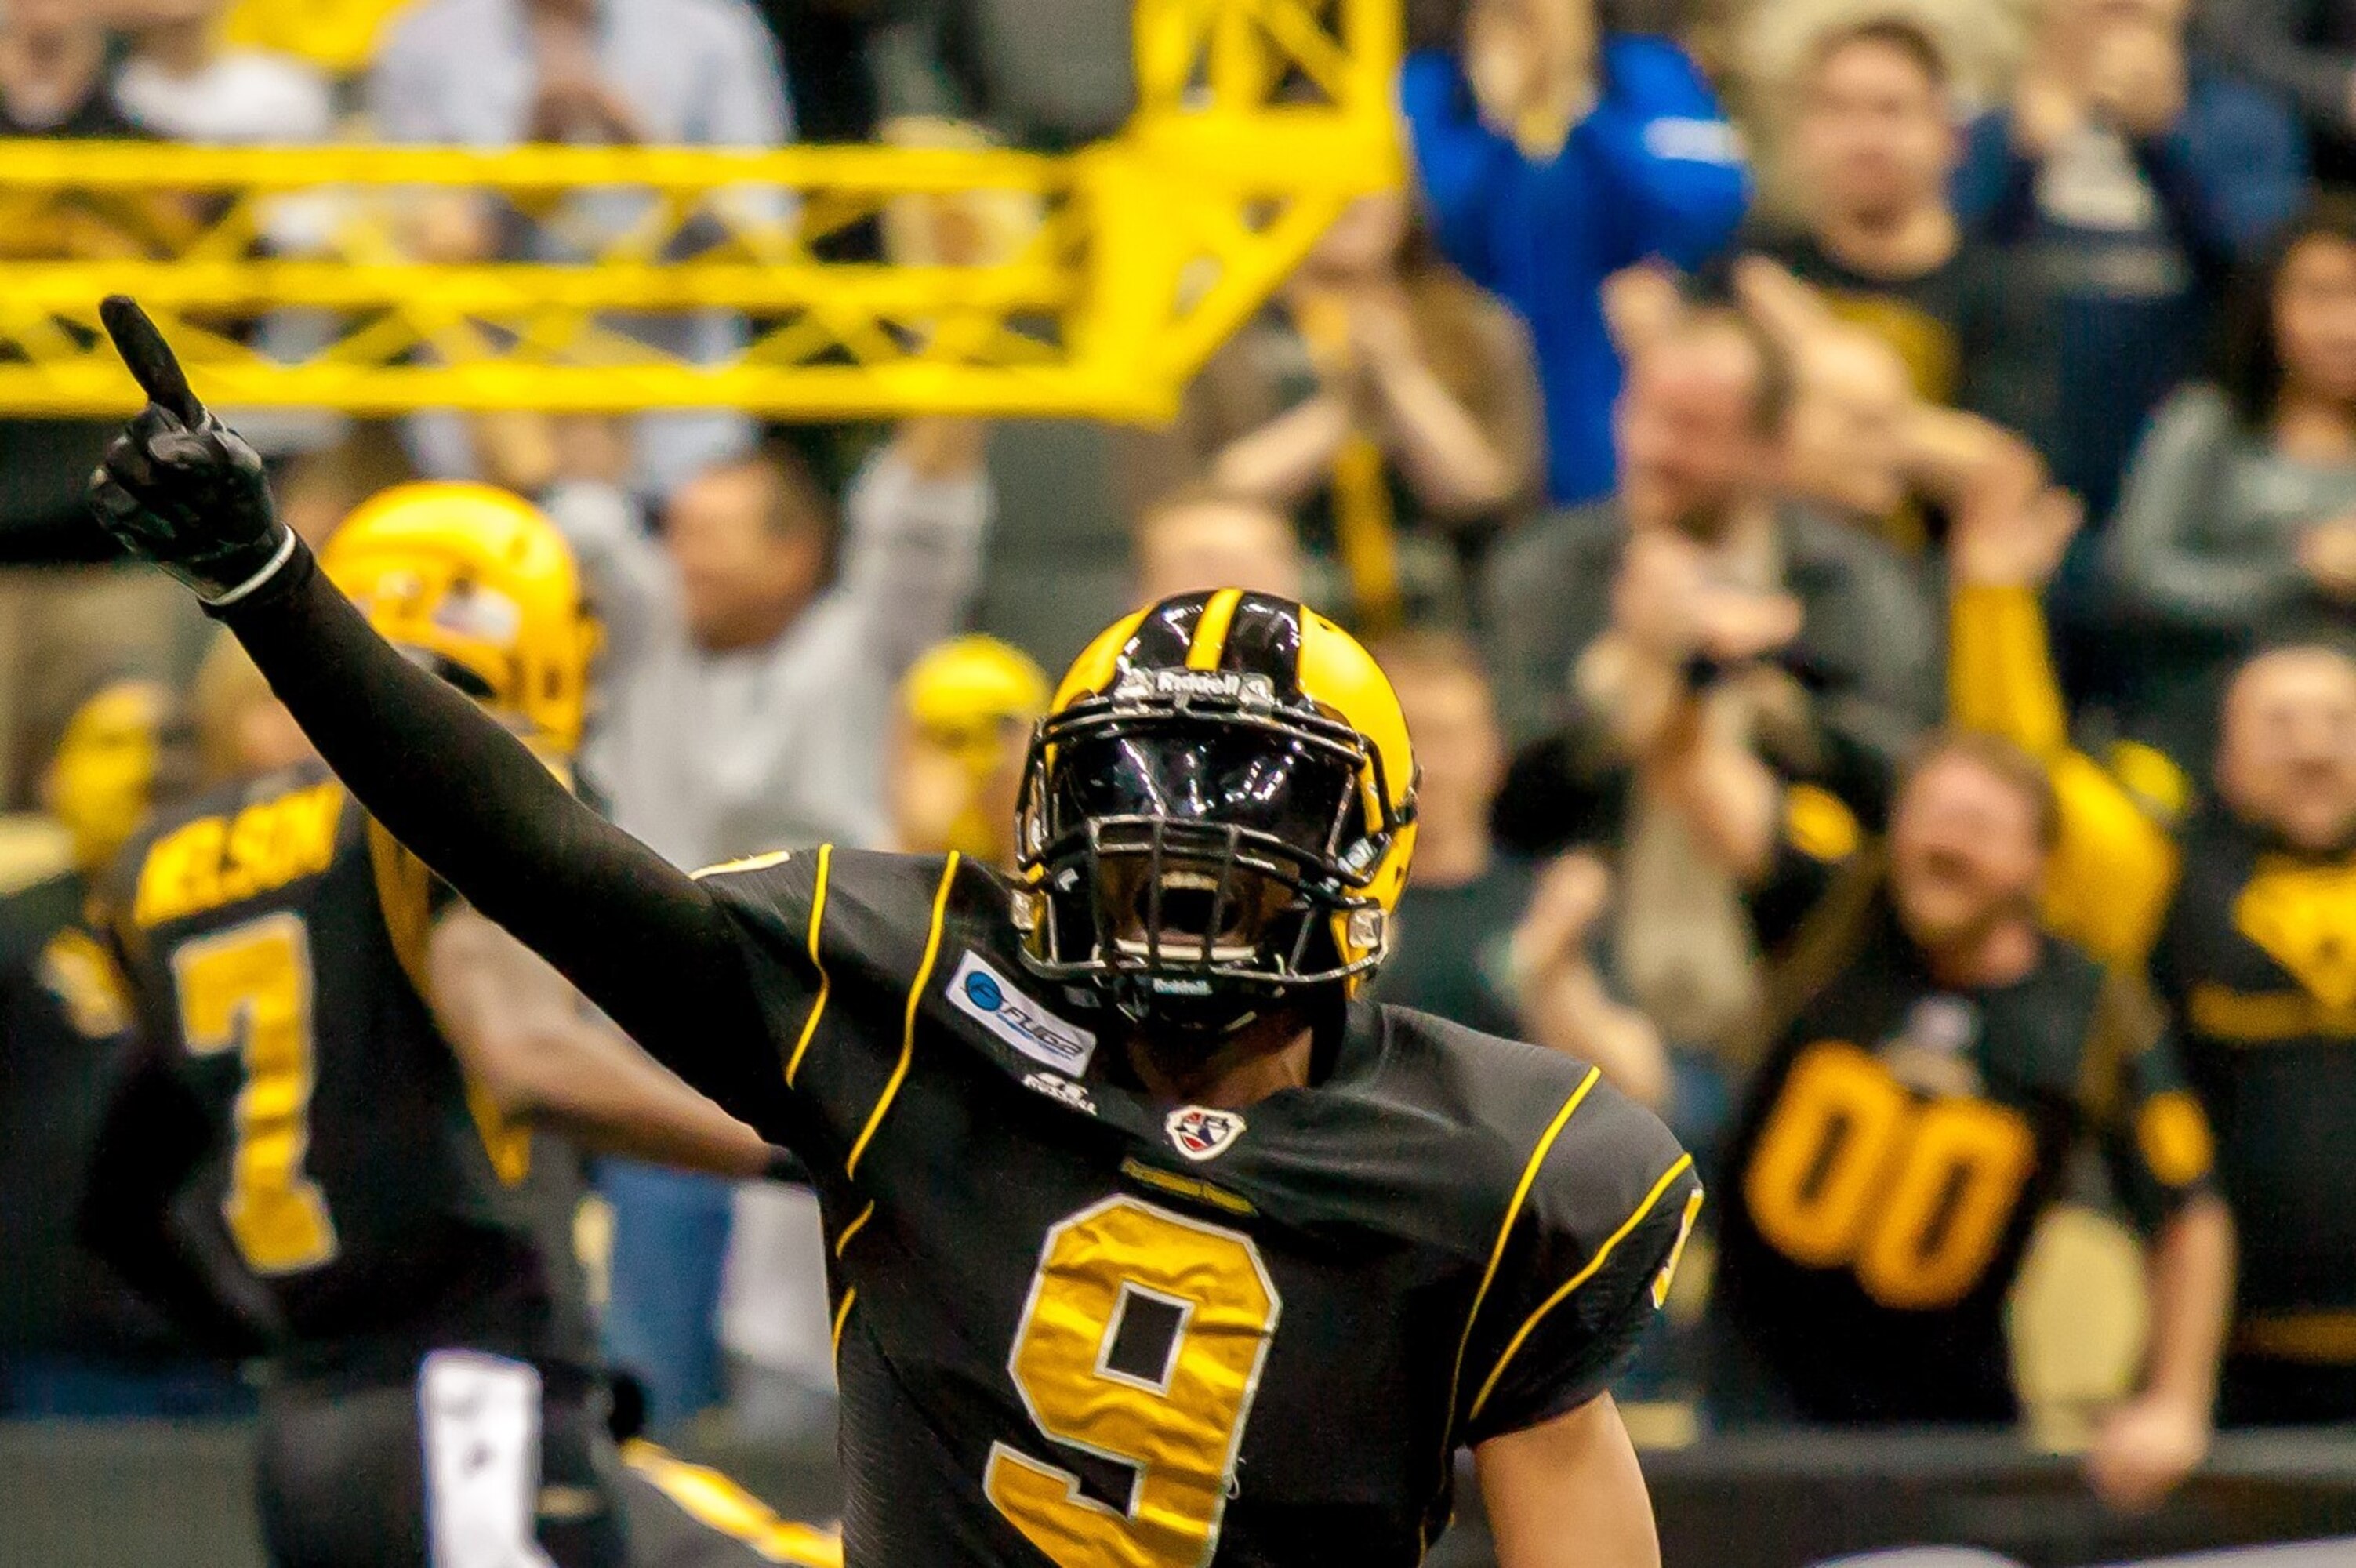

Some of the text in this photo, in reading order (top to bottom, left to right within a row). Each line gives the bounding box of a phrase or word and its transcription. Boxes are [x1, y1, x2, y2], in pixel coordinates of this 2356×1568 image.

[171, 909, 317, 1276] 7
[1744, 1038, 2036, 1310] 00
[983, 1192, 1283, 1567] 9
